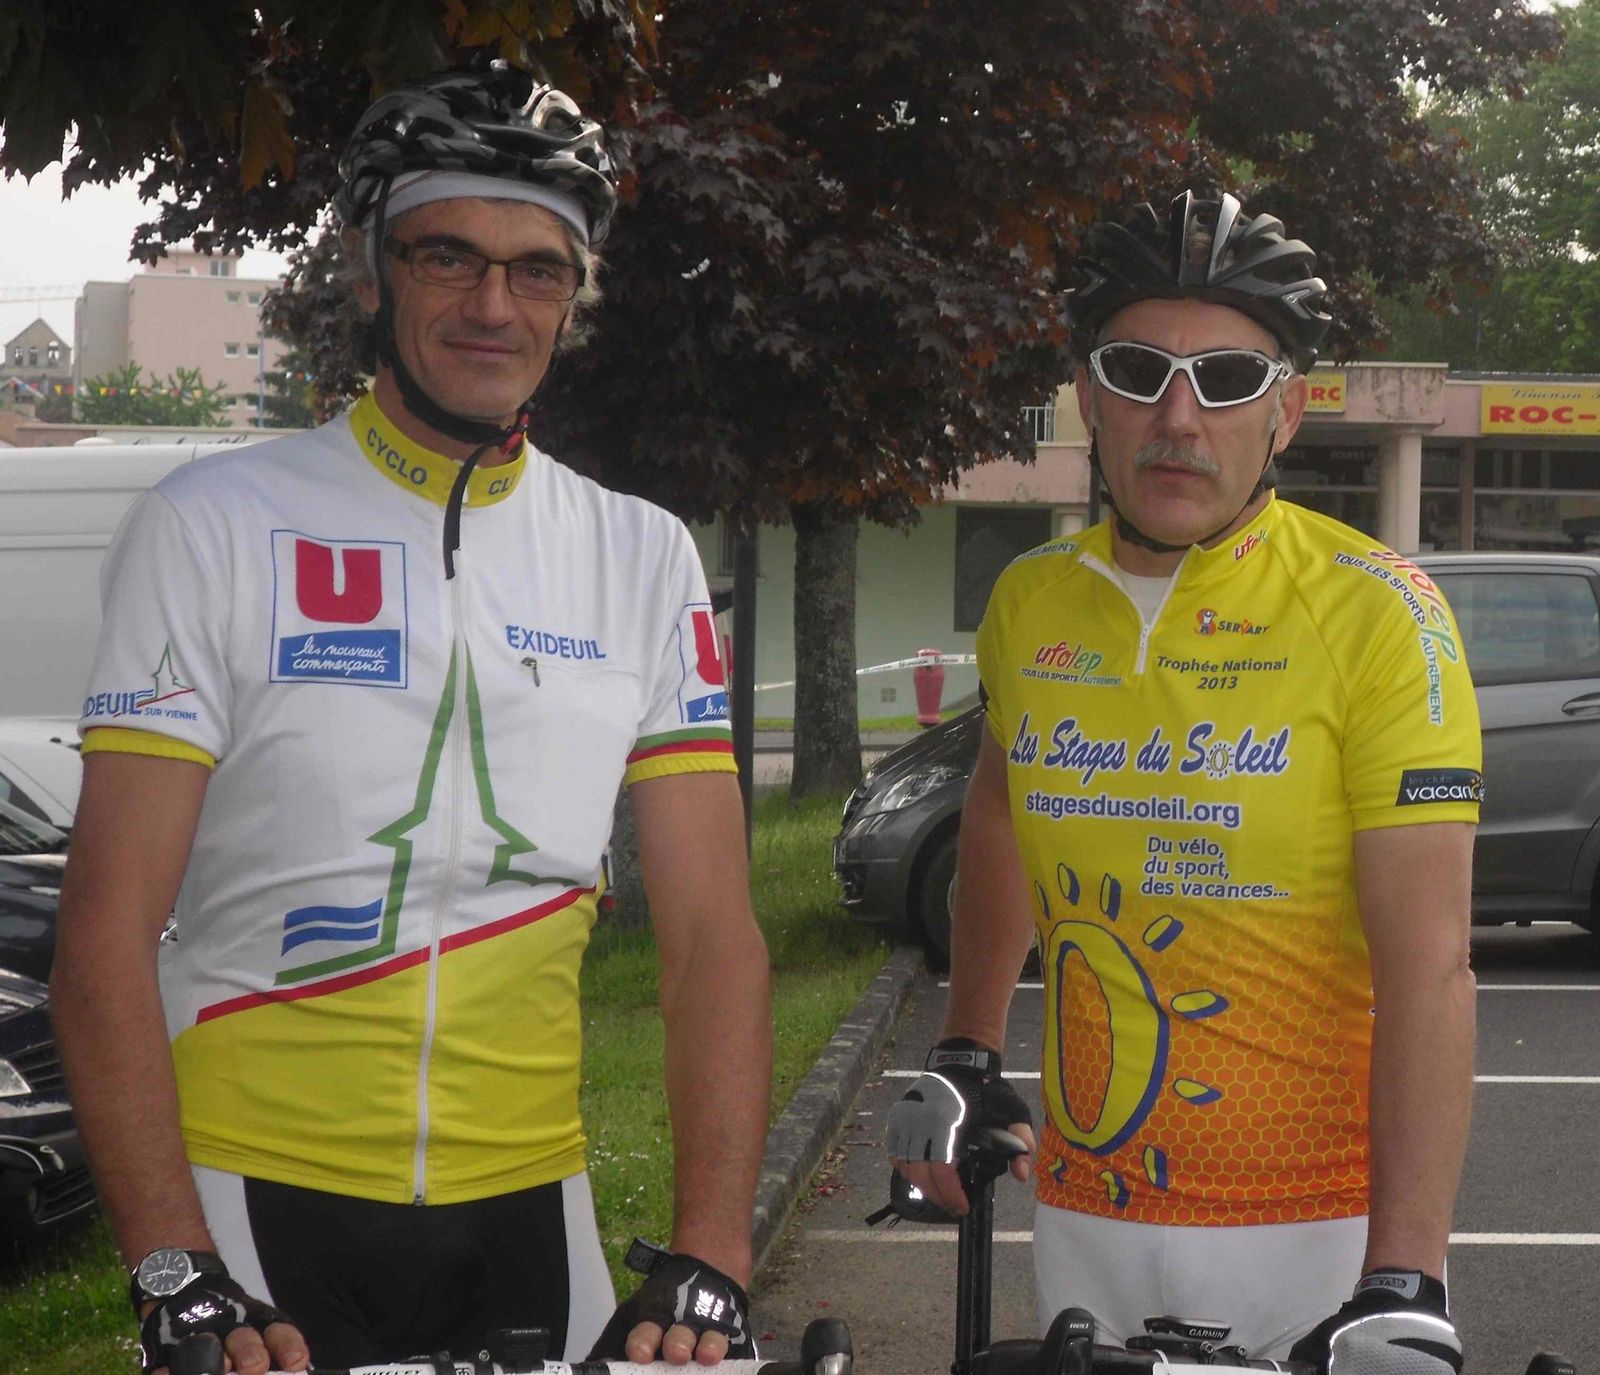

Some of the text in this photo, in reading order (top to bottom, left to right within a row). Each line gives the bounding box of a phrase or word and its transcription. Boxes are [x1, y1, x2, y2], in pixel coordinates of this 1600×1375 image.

[366, 427, 427, 485] CYCLO
[295, 538, 383, 624] U
[291, 634, 386, 659] les nouveaux
[505, 624, 607, 661] EXIDEUIL
[1334, 553, 1442, 724] TOUS LES SPORTS AUTREMENT
[292, 657, 389, 676] commerçants
[1034, 640, 1103, 680] ufolep
[1157, 655, 1288, 673] Trophée National
[1021, 667, 1123, 687] TOUS LES SPORTS AUTREMENT
[1196, 676, 1239, 690] 2013
[144, 707, 162, 717] SUR
[165, 709, 198, 721] VIENNE
[1009, 713, 1290, 785] Les Stages du Soleil
[1026, 792, 1240, 828] stagesdusoleil.org
[1148, 836, 1225, 858] Du vélo,
[1144, 856, 1230, 880] du sport,
[1141, 877, 1290, 898] des vacances...
[1189, 1328, 1225, 1339] GARMIN
